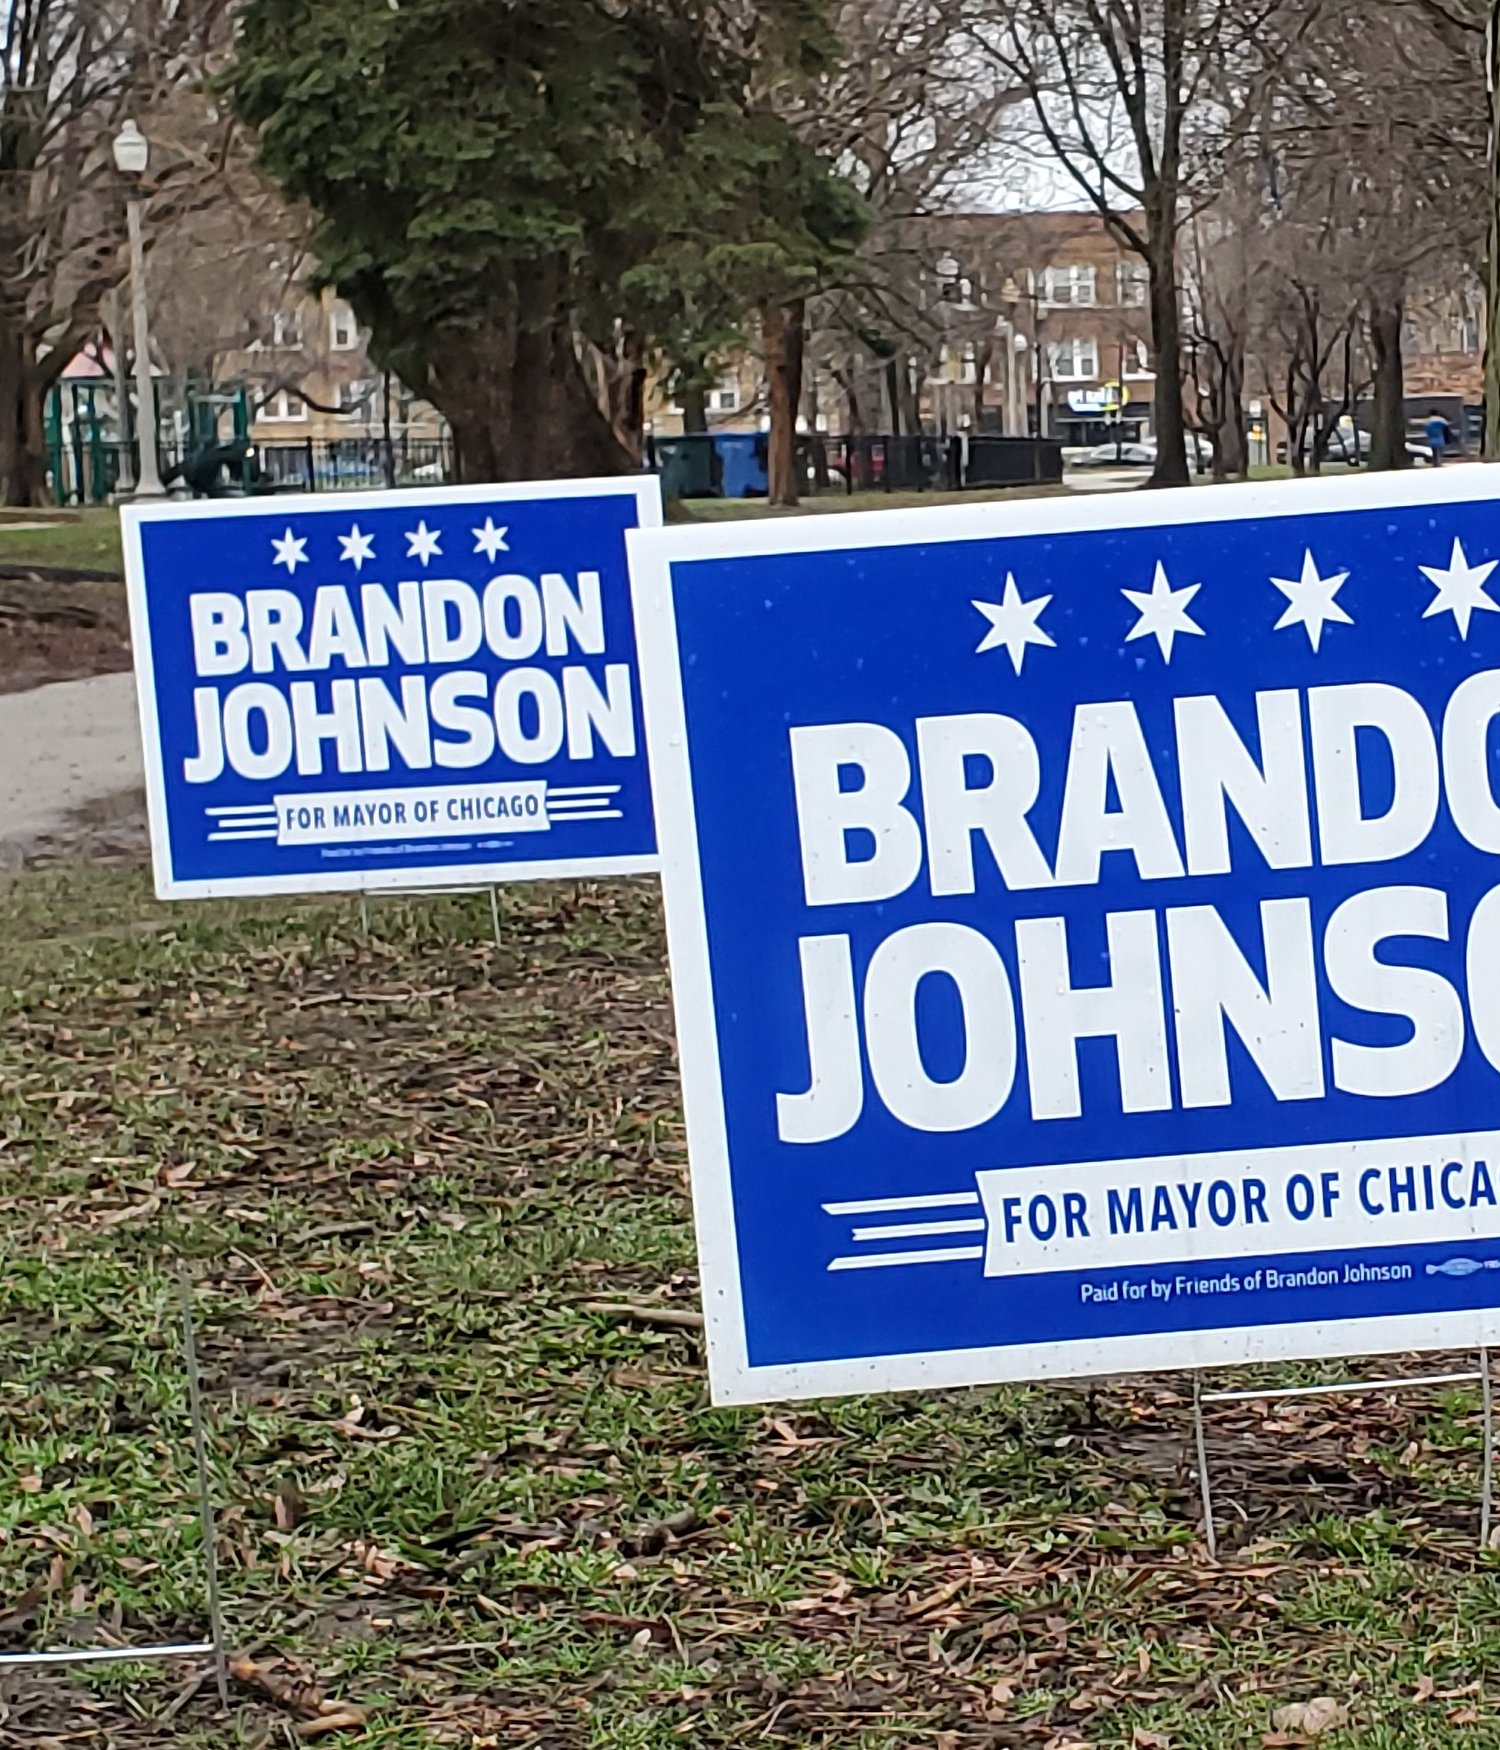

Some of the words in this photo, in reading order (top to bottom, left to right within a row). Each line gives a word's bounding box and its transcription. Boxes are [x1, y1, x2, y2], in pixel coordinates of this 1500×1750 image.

[189, 571, 606, 677] BRANDON
[184, 663, 636, 783] JOHNSON
[286, 807, 326, 830] FOR
[333, 803, 407, 827] MAYOR
[414, 800, 440, 823] OF
[446, 794, 539, 821] CHICAGO
[1002, 1192, 1091, 1243] FOR
[1107, 1179, 1271, 1235] MAYOR
[1285, 1171, 1340, 1221] OF
[1081, 1282, 1119, 1302] Paid
[1122, 1280, 1148, 1299] for
[1151, 1279, 1172, 1302] by
[1175, 1273, 1241, 1295] Friends
[1243, 1270, 1262, 1290] of
[1266, 1267, 1339, 1289] Brandon
[1343, 1263, 1412, 1284] Johnson
